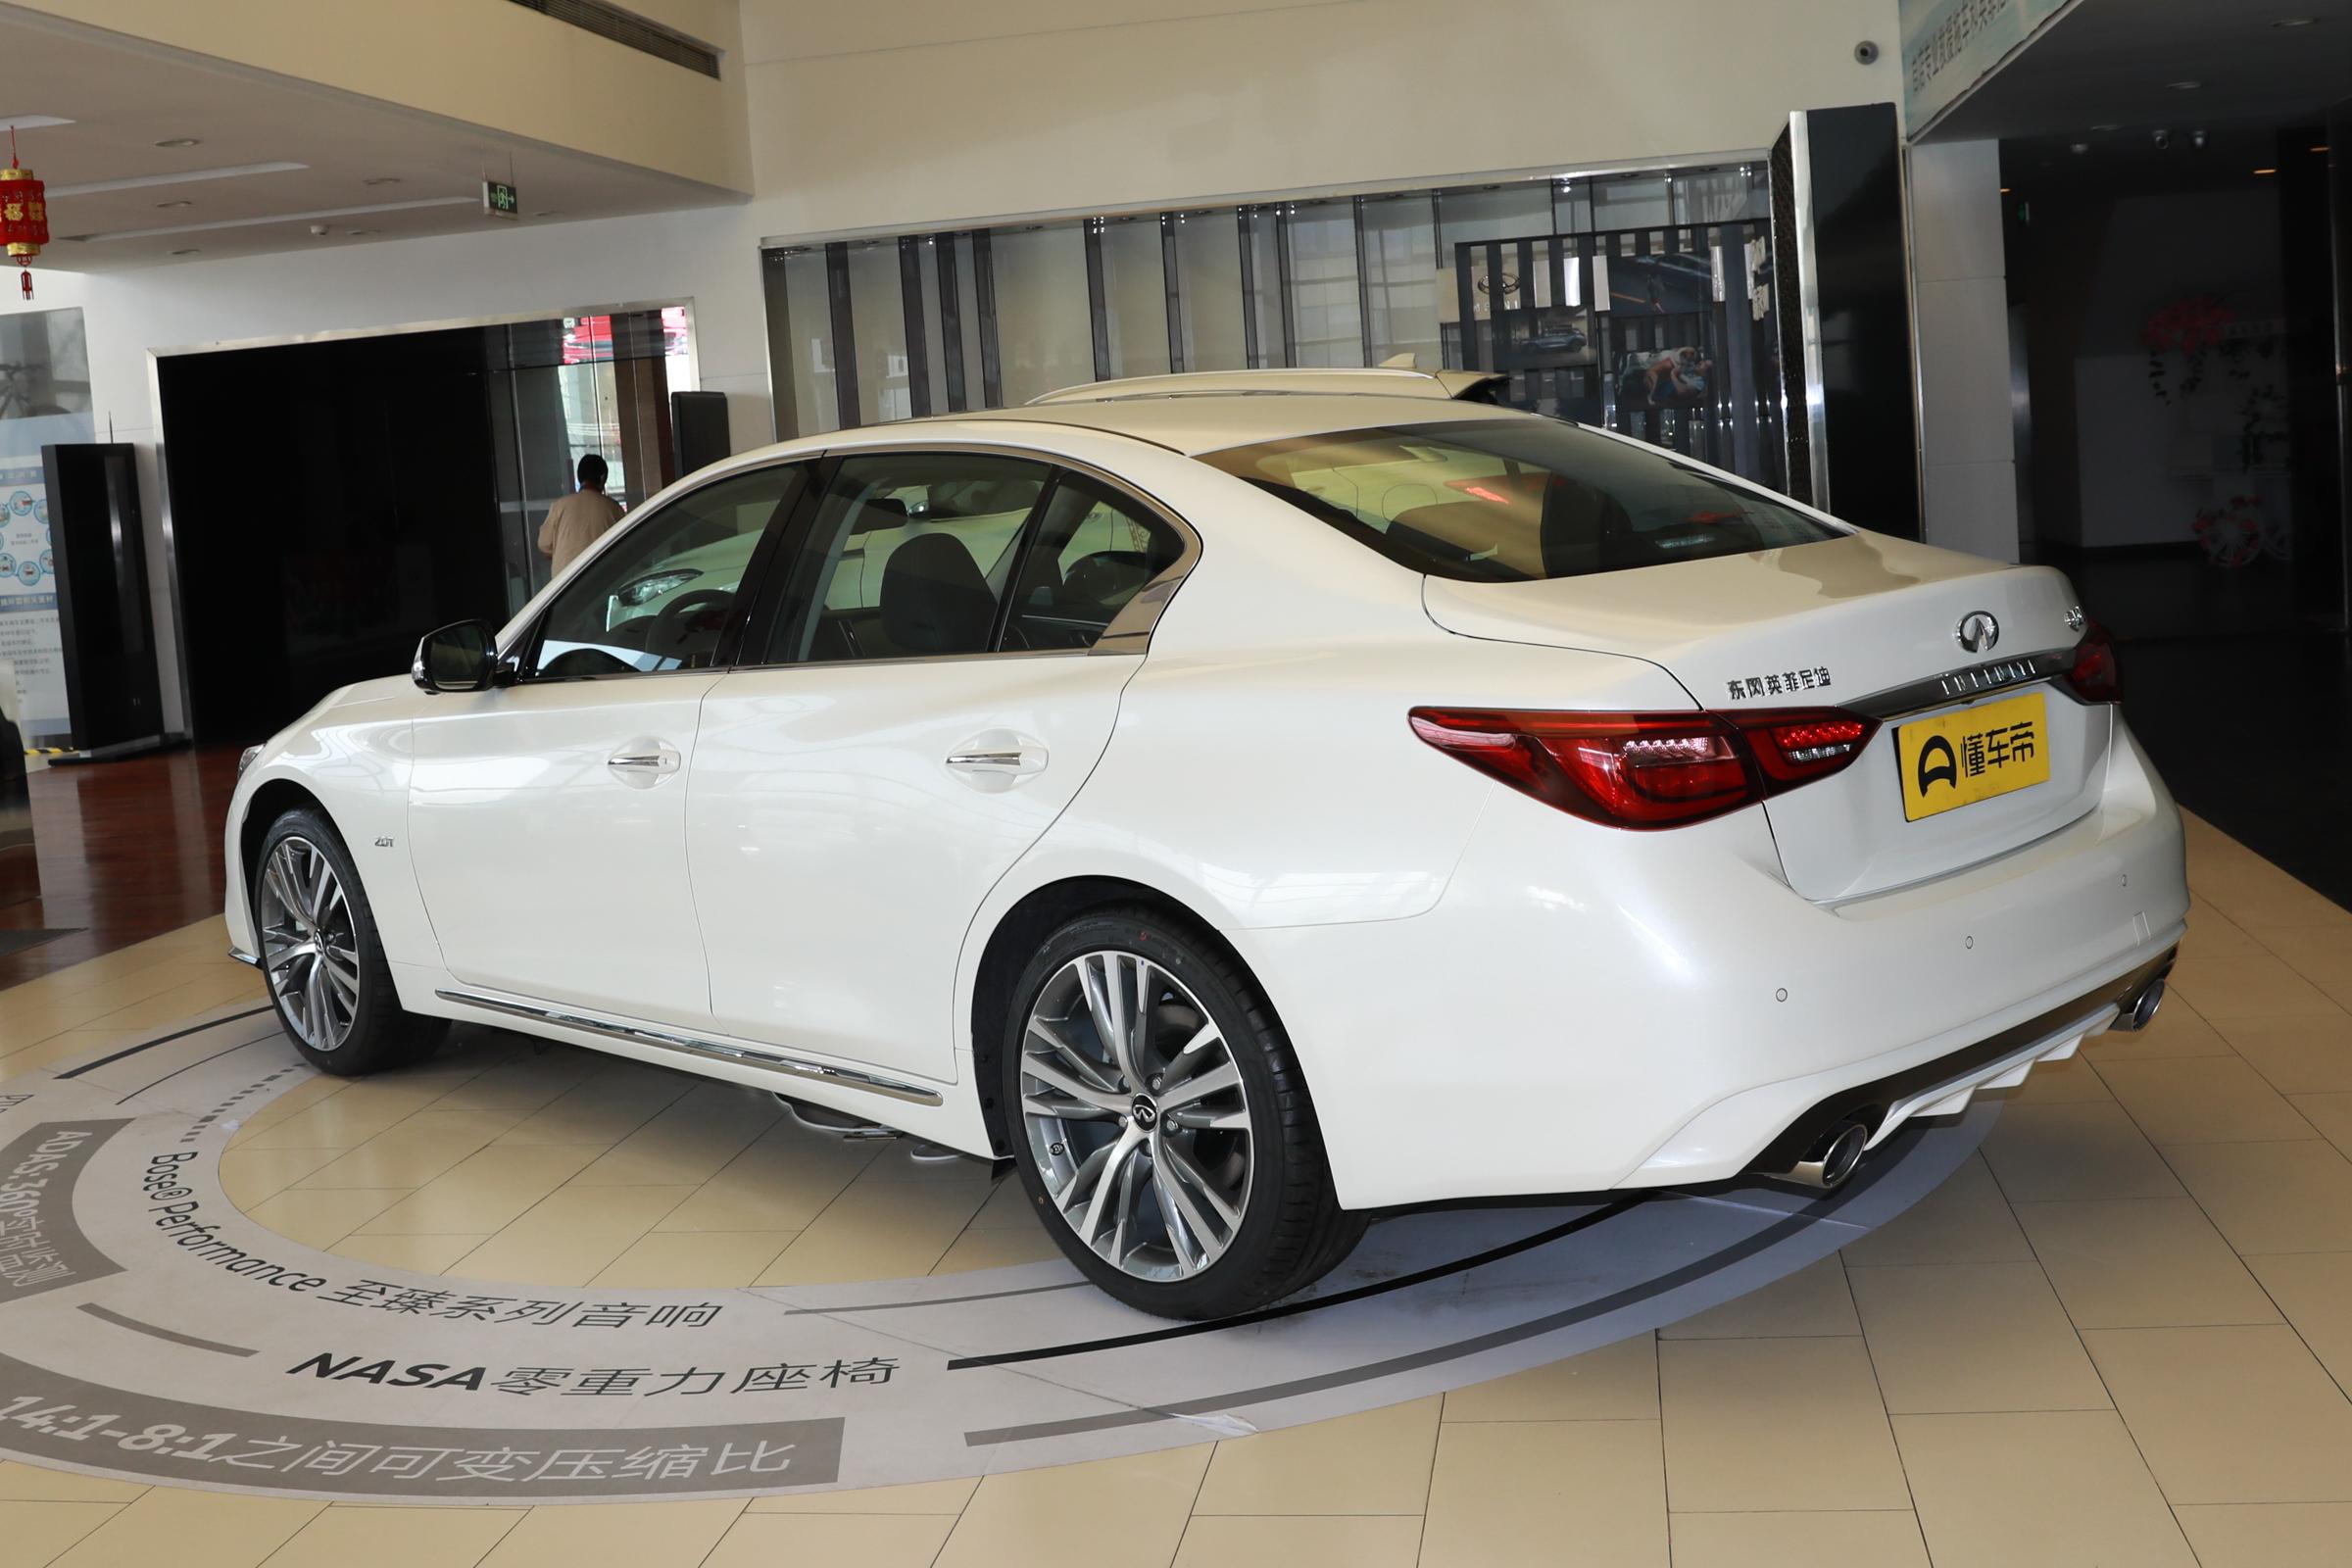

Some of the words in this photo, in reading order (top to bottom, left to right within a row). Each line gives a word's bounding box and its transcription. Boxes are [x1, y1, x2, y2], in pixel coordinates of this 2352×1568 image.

[1727, 666, 1831, 702] 东风英菲尼迪
[1961, 720, 2035, 778] 懂车帝
[148, 1200, 327, 1293] Performance
[317, 1279, 724, 1330] 至臻系列音响
